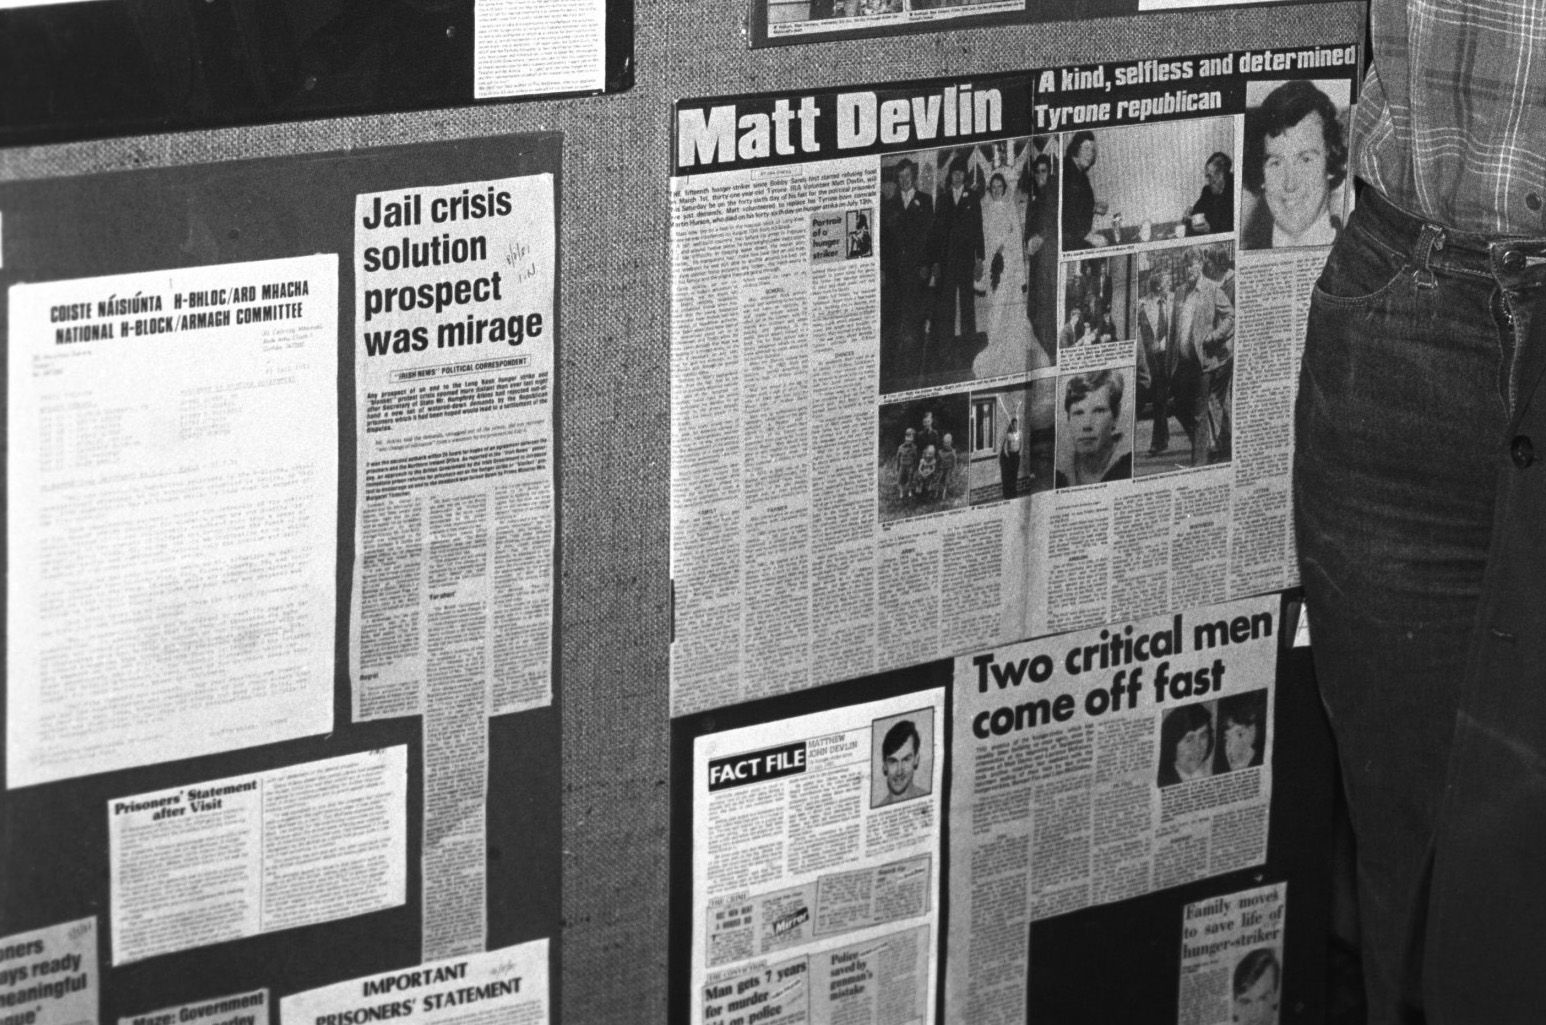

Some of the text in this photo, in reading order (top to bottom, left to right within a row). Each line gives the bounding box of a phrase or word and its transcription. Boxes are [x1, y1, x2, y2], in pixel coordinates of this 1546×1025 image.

[1038, 45, 1357, 93] A kind, selfless and determined
[678, 83, 1003, 168] Matt Devlin
[1034, 89, 1223, 131] Tyrone republican
[769, 179, 787, 187] Bobby
[864, 169, 876, 177] food
[363, 186, 512, 230] Jail crisis
[812, 216, 842, 227] Portrait
[812, 228, 821, 238] of
[812, 238, 841, 249] hunger
[363, 233, 487, 273] solution
[812, 249, 839, 260] striker
[50, 280, 310, 323] COISTE NÁISIÚNTA H-BHLOC/ARD MHACHA
[364, 271, 502, 322] prospect
[55, 322, 114, 345] NATIONAL
[236, 302, 304, 325] COMMITTEE
[363, 312, 543, 357] was mirage
[441, 364, 474, 375] POLITICAL
[475, 357, 528, 370] CORRESPONDENT
[973, 611, 1272, 693] Two critical men
[972, 659, 1226, 739] come off fast
[808, 734, 846, 748] MATTHEW
[808, 741, 858, 758] JOHN DEVLIN
[710, 749, 805, 785] FACT FILE
[115, 780, 258, 816] Prisoners' Statement
[152, 798, 223, 821] after Visit
[1184, 904, 1284, 939] to save life of
[1187, 898, 1231, 921] Family
[1183, 928, 1280, 959] hunger-striker
[31, 953, 82, 977] ready
[363, 962, 468, 997] IMPORTANT
[705, 962, 806, 1001] Man gets 7 years
[179, 991, 265, 1023] Government
[423, 977, 523, 1013] STATEMENT
[705, 992, 769, 1019] for murder
